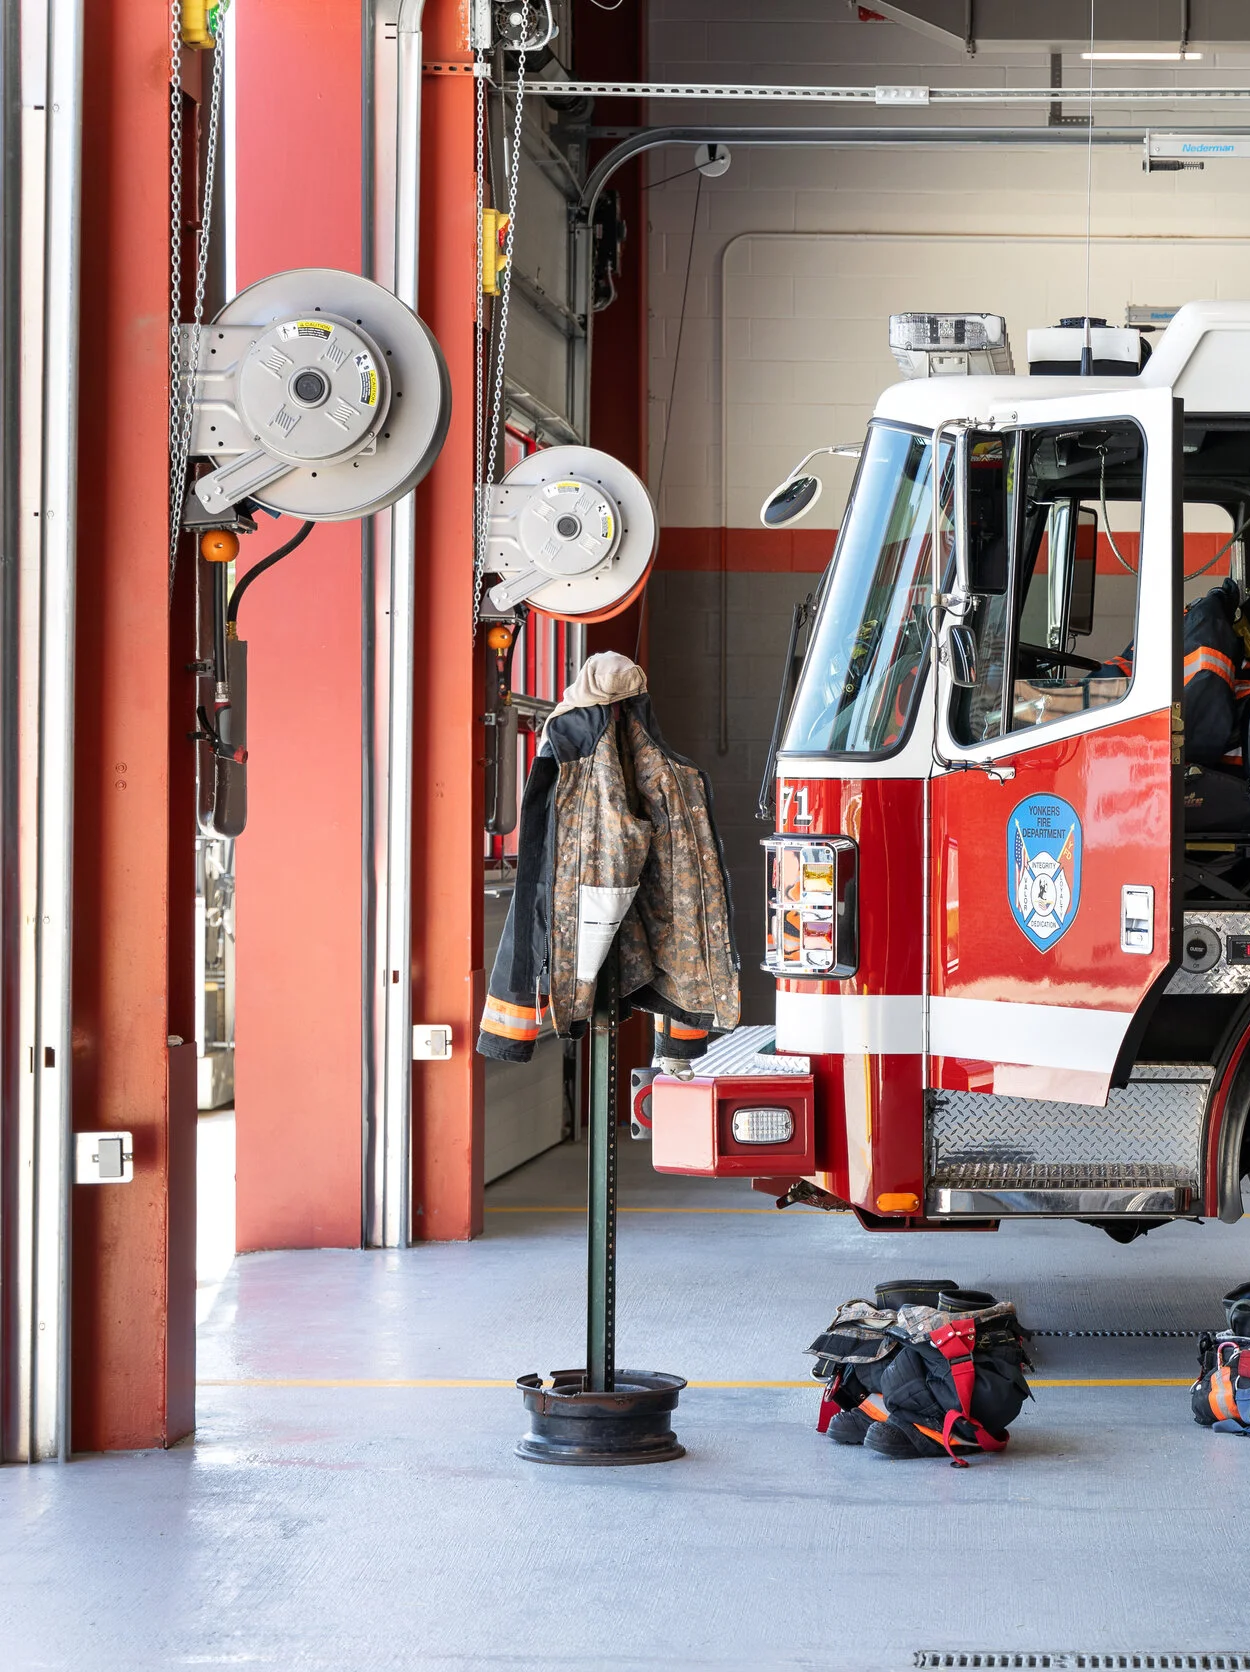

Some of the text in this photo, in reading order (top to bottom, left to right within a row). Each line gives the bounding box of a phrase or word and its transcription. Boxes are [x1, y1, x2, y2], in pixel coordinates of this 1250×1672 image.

[1182, 144, 1234, 153] Nederman
[1028, 805, 1061, 816] YONKERS
[1037, 818, 1052, 828] FIRE
[1022, 828, 1066, 839] DEPARTMENT
[1031, 861, 1056, 870] INTEGRITY
[1031, 920, 1057, 929] DEDICATION
